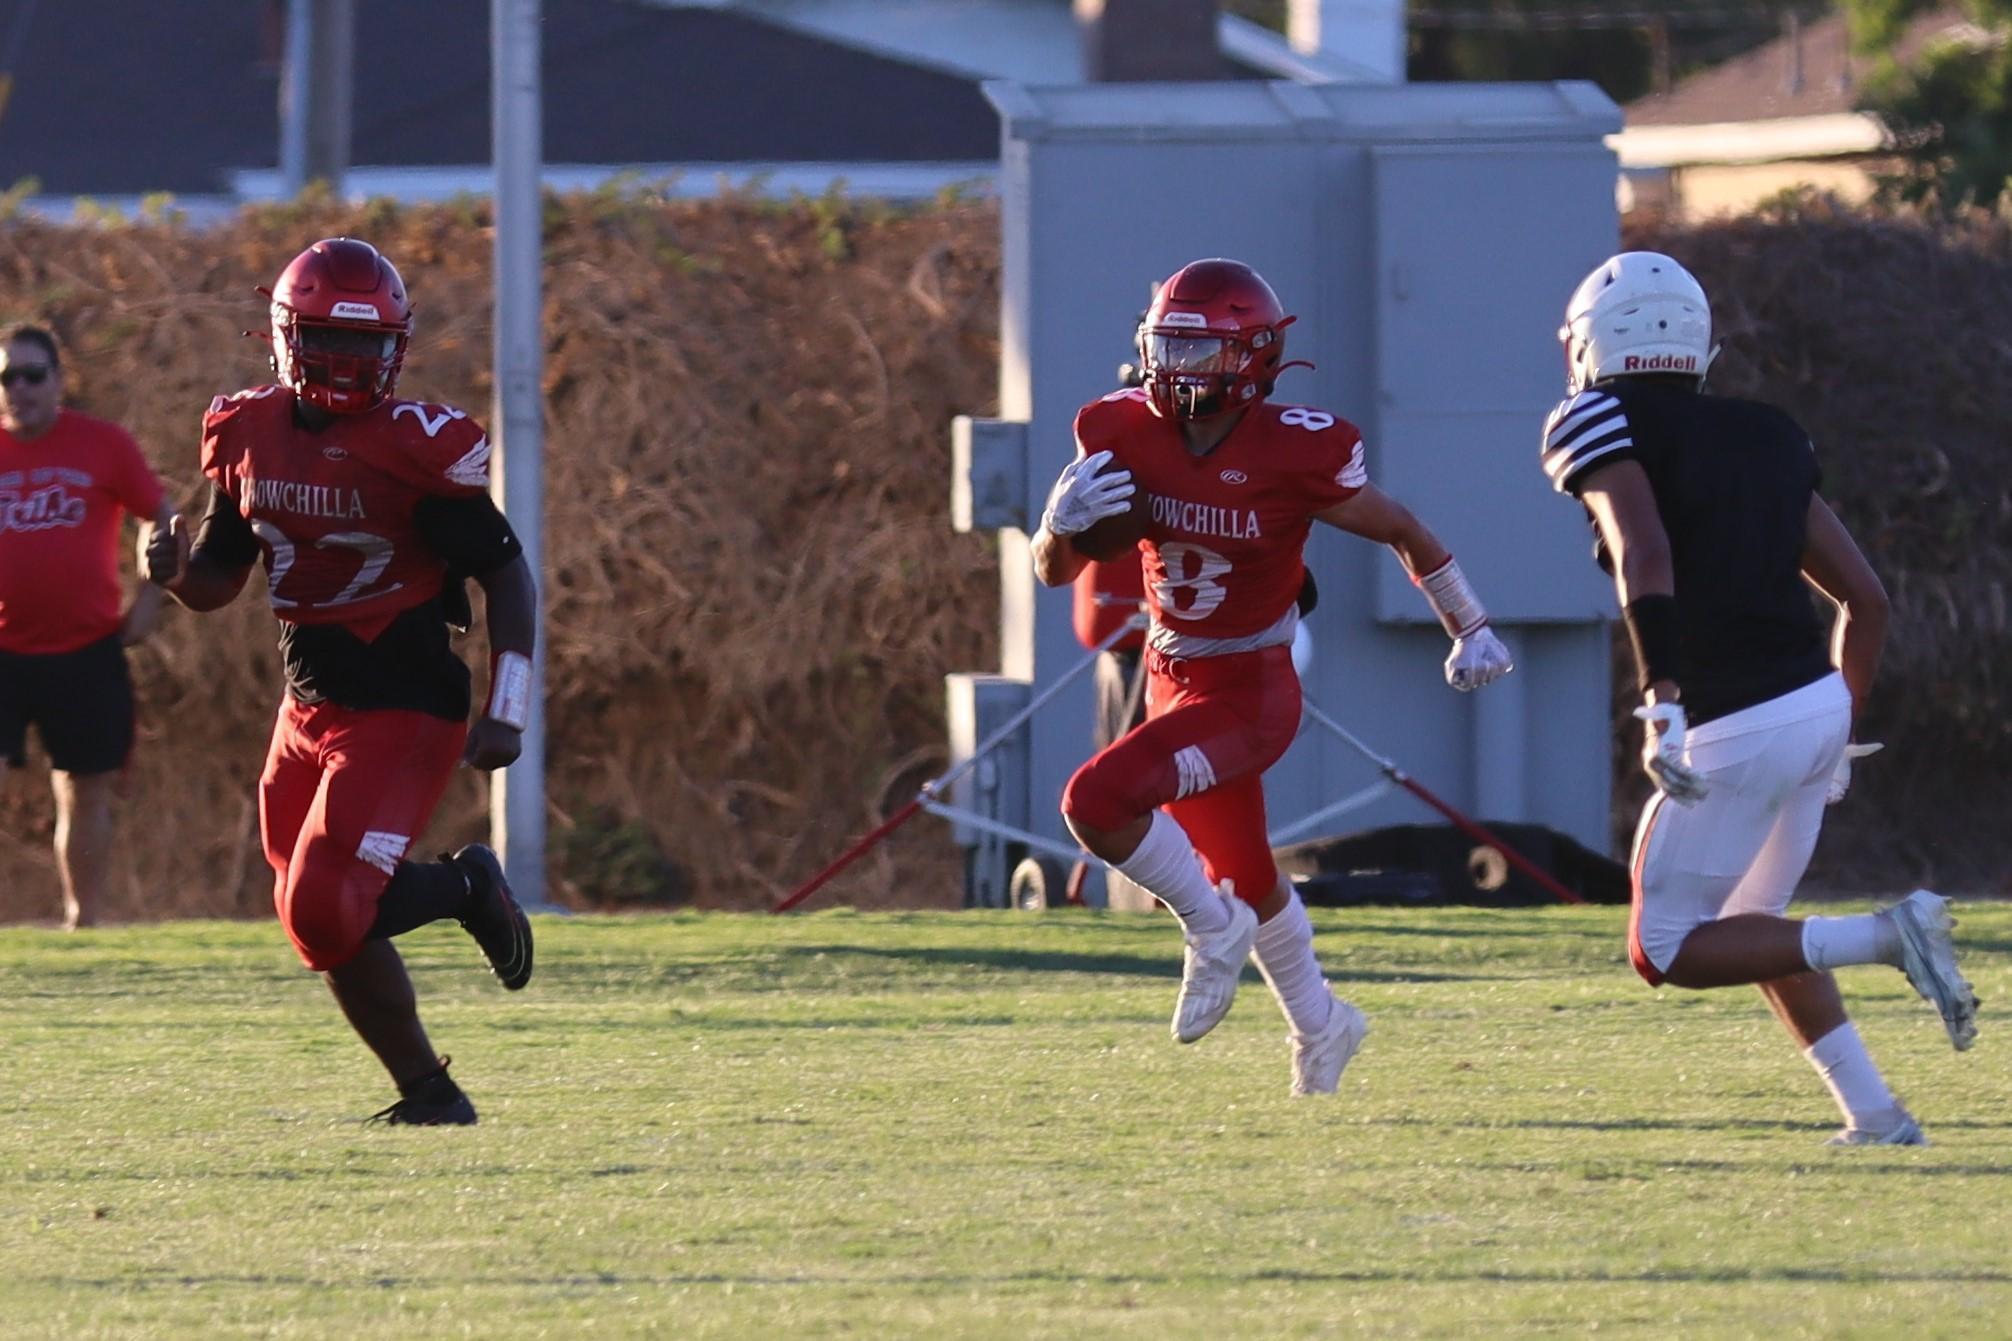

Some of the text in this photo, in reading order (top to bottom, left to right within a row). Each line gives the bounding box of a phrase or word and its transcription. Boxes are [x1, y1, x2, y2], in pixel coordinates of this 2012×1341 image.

[1625, 354, 1696, 371] Riddell
[1280, 408, 1334, 431] 8
[1148, 493, 1262, 539] OWCHILLA
[251, 518, 404, 609] 22
[1151, 541, 1233, 621] 8
